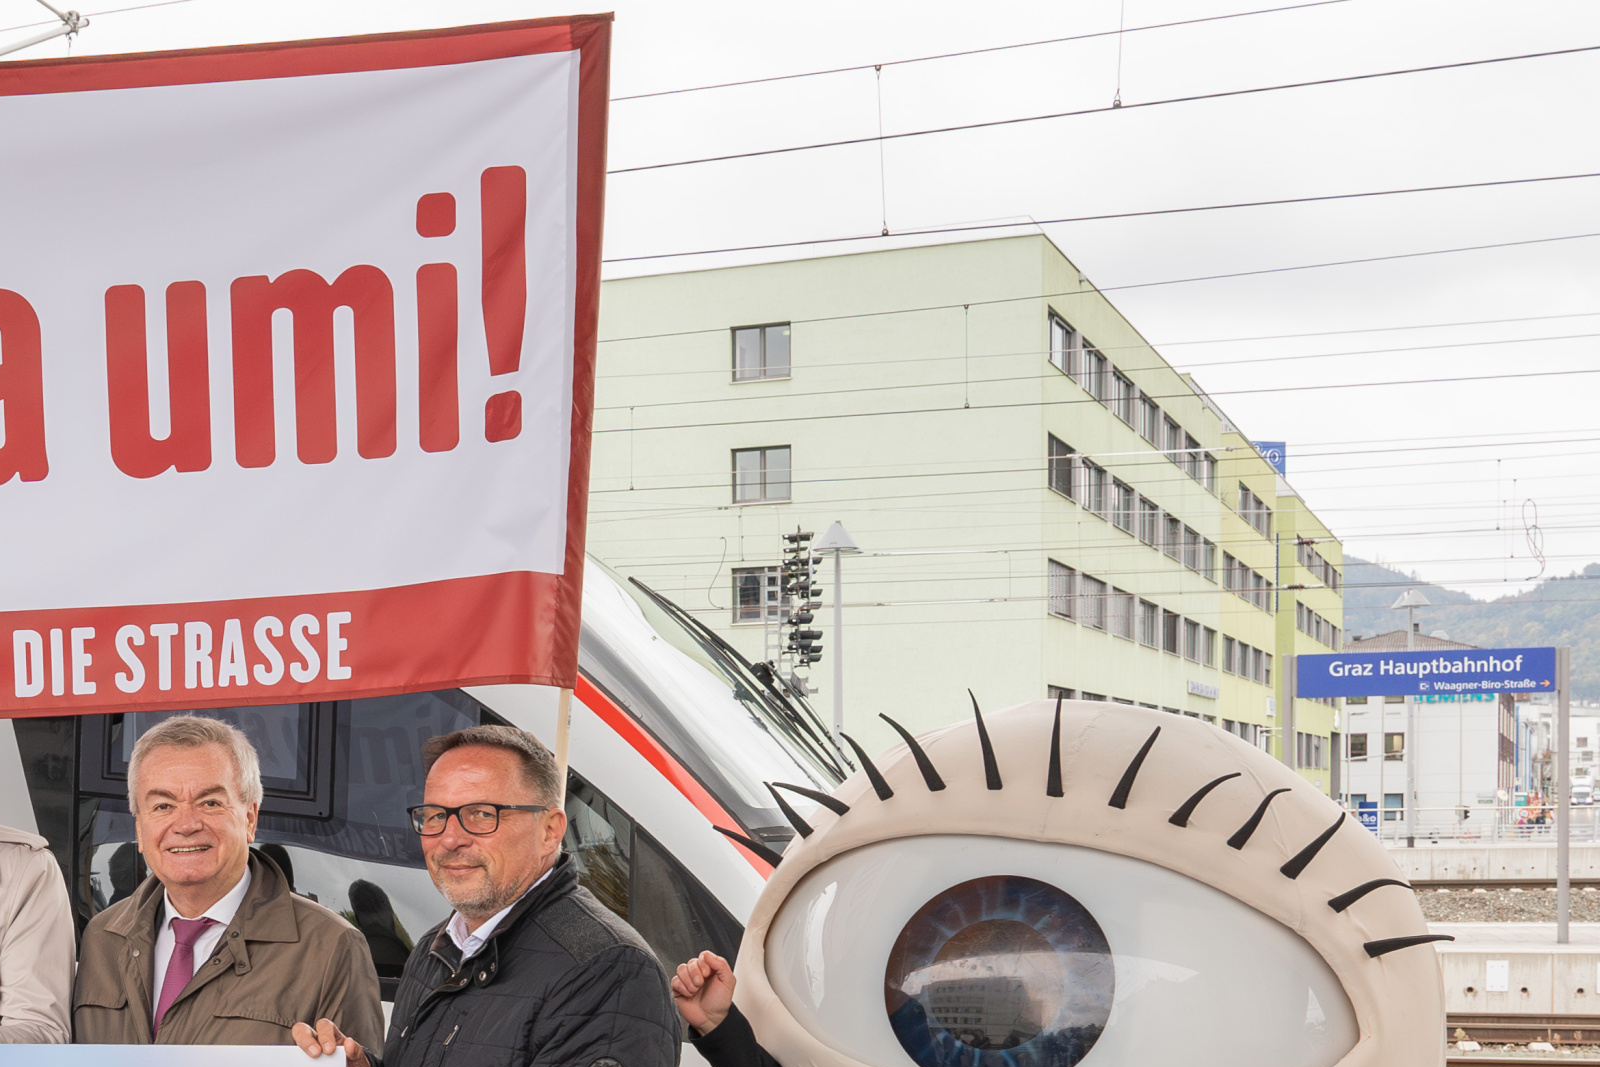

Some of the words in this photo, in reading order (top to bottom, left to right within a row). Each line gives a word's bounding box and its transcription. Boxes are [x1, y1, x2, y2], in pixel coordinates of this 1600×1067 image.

[104, 165, 528, 480] umi!
[13, 626, 97, 698] DIE
[114, 611, 353, 694] STRASSE
[1328, 661, 1373, 677] Graz
[1379, 654, 1524, 679] Hauptbahnhof
[1433, 678, 1537, 692] Waagner-Biro-Straße
[1413, 692, 1496, 704] IEMENS
